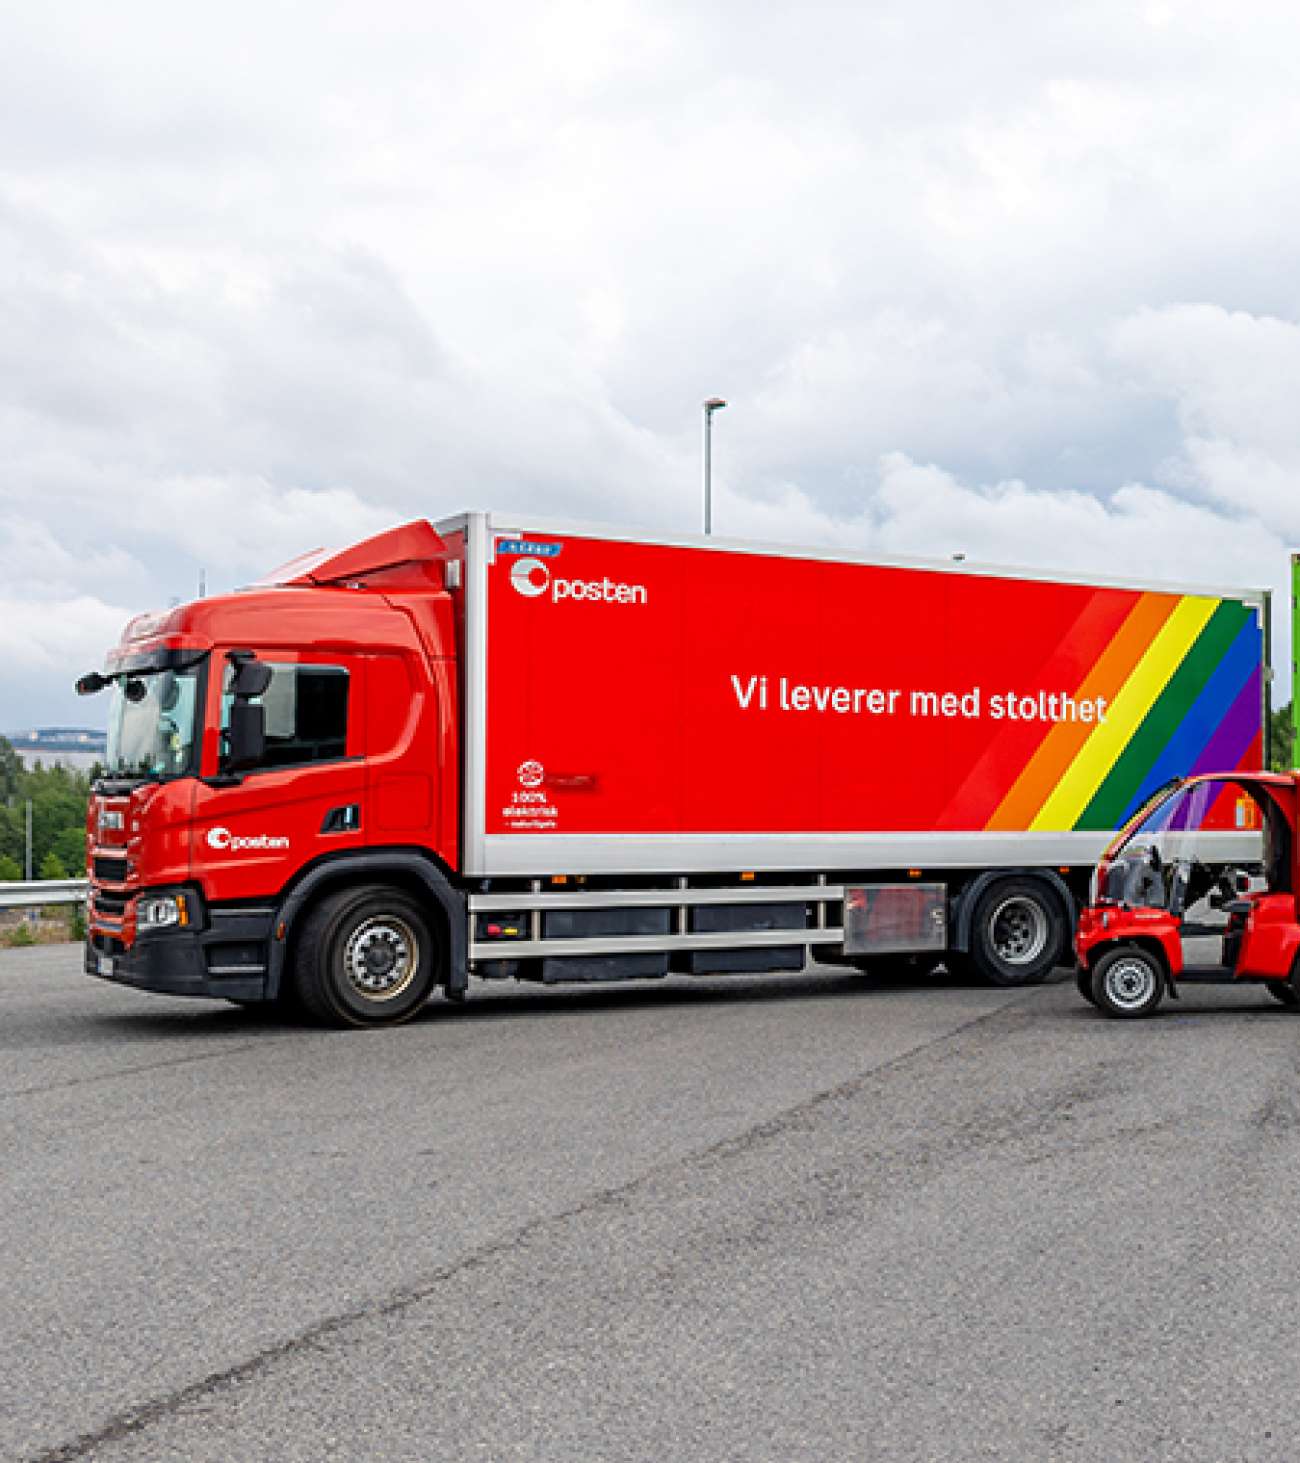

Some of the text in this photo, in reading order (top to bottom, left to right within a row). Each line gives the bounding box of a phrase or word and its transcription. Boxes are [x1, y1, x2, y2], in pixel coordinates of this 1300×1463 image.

[552, 576, 647, 604] posten
[731, 674, 1108, 724] Vi leverer med stolthet
[231, 834, 289, 852] posten
